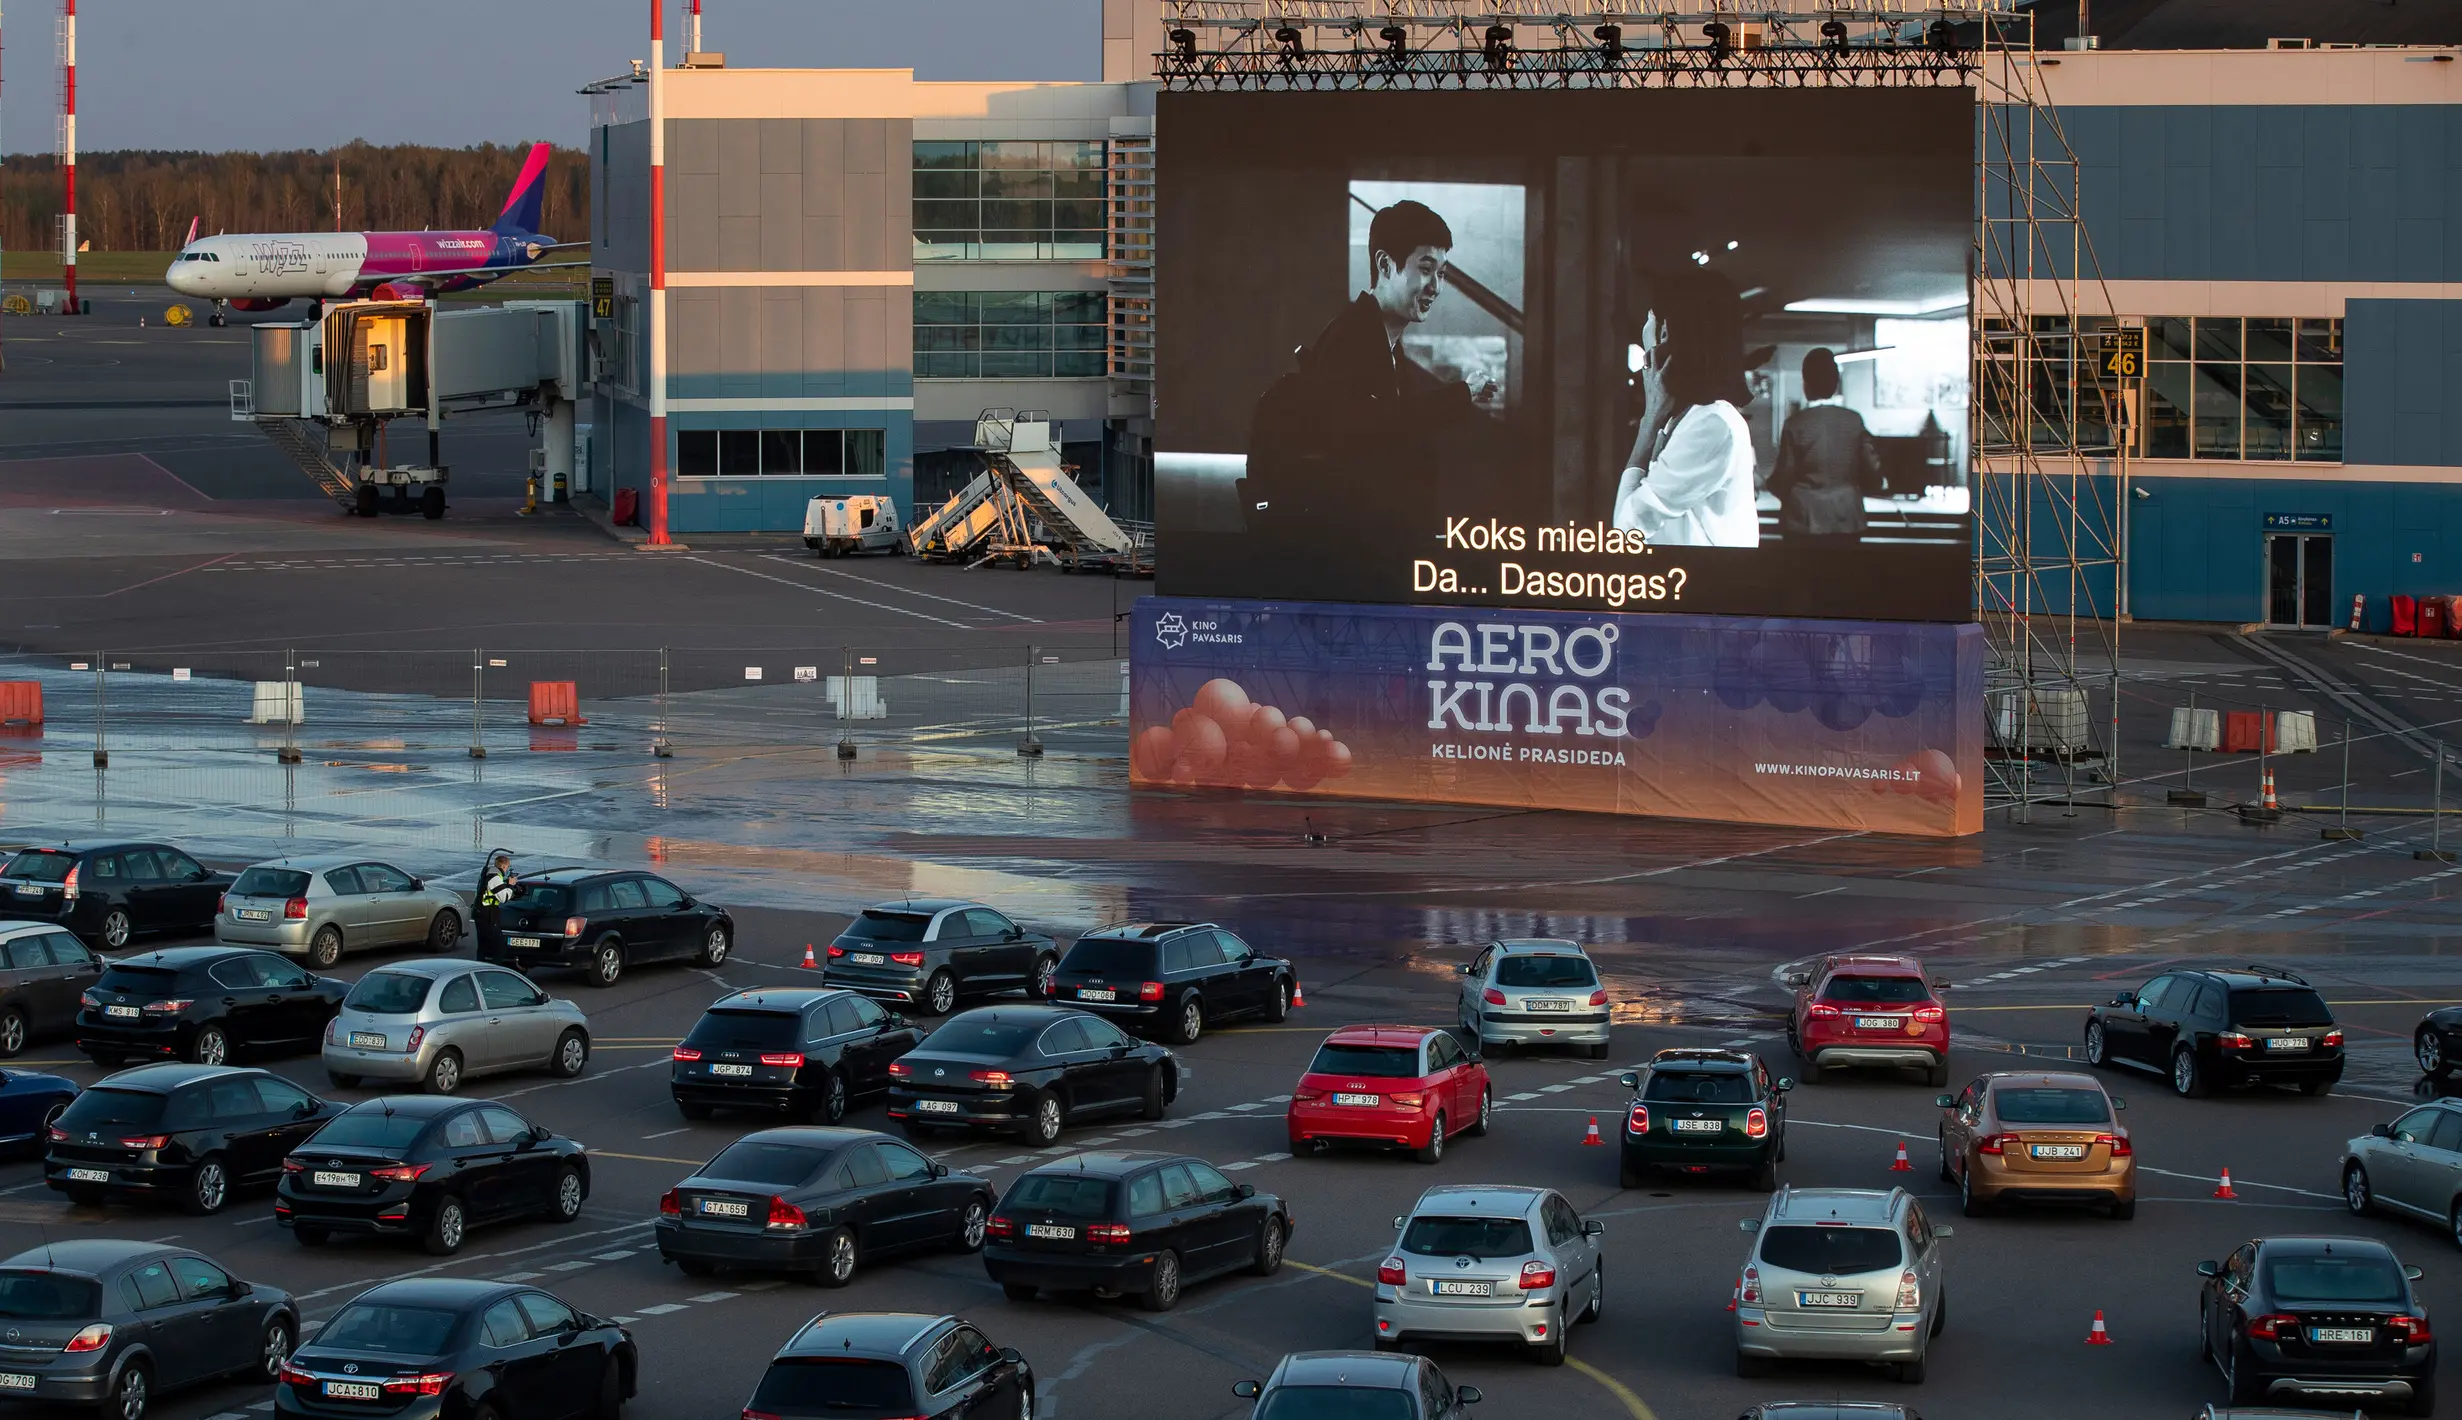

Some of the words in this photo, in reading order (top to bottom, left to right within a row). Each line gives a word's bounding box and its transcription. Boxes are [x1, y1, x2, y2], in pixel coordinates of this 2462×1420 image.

[436, 239, 485, 249] wizzair.com
[596, 298, 610, 316] 47
[2108, 352, 2135, 375] 46
[2278, 516, 2289, 524] A5
[1446, 517, 1526, 550] Koks
[1538, 520, 1653, 554] mielas.
[1414, 560, 1487, 593] Da...
[1501, 562, 1687, 607] Dasongas?
[1192, 621, 1218, 630] KINO
[1192, 634, 1242, 644] PAVASARIS
[1426, 622, 1619, 677] AERO
[1428, 680, 1630, 736] KINAS
[1432, 743, 1513, 761] KELIONĖ
[1520, 748, 1626, 766] PRASIDEDA
[1755, 763, 1920, 782] WWW.KINOPAVASARIS.LT
[853, 954, 868, 962] KPP
[870, 956, 882, 964] 002
[1554, 1001, 1567, 1009] 787
[126, 1008, 138, 1016] 919
[354, 1034, 368, 1044] EDD
[372, 1036, 384, 1046] 837
[714, 1064, 731, 1073] JGP
[736, 1066, 750, 1074] 874
[1338, 1094, 1356, 1102] HPT
[1362, 1096, 1378, 1104] 978
[920, 1100, 936, 1109] LAG
[942, 1102, 956, 1111] 097
[1679, 1121, 1698, 1130] JSE
[1704, 1122, 1720, 1130] 838
[2038, 1146, 2058, 1155] JJB
[2064, 1147, 2080, 1156] 241
[92, 1172, 108, 1180] 238
[706, 1202, 724, 1212] GTA
[730, 1204, 746, 1214] 659
[1031, 1226, 1051, 1236] HRM
[1056, 1228, 1074, 1238] 630
[1440, 1284, 1463, 1292] LCU
[1469, 1284, 1488, 1294] 239
[1808, 1294, 1830, 1304] JJC
[1836, 1295, 1856, 1304] 939
[2320, 1330, 2342, 1340] HRE
[2351, 1330, 2369, 1340] 161
[16, 1376, 34, 1386] 709
[329, 1384, 350, 1395] JCA
[358, 1386, 377, 1396] 810
